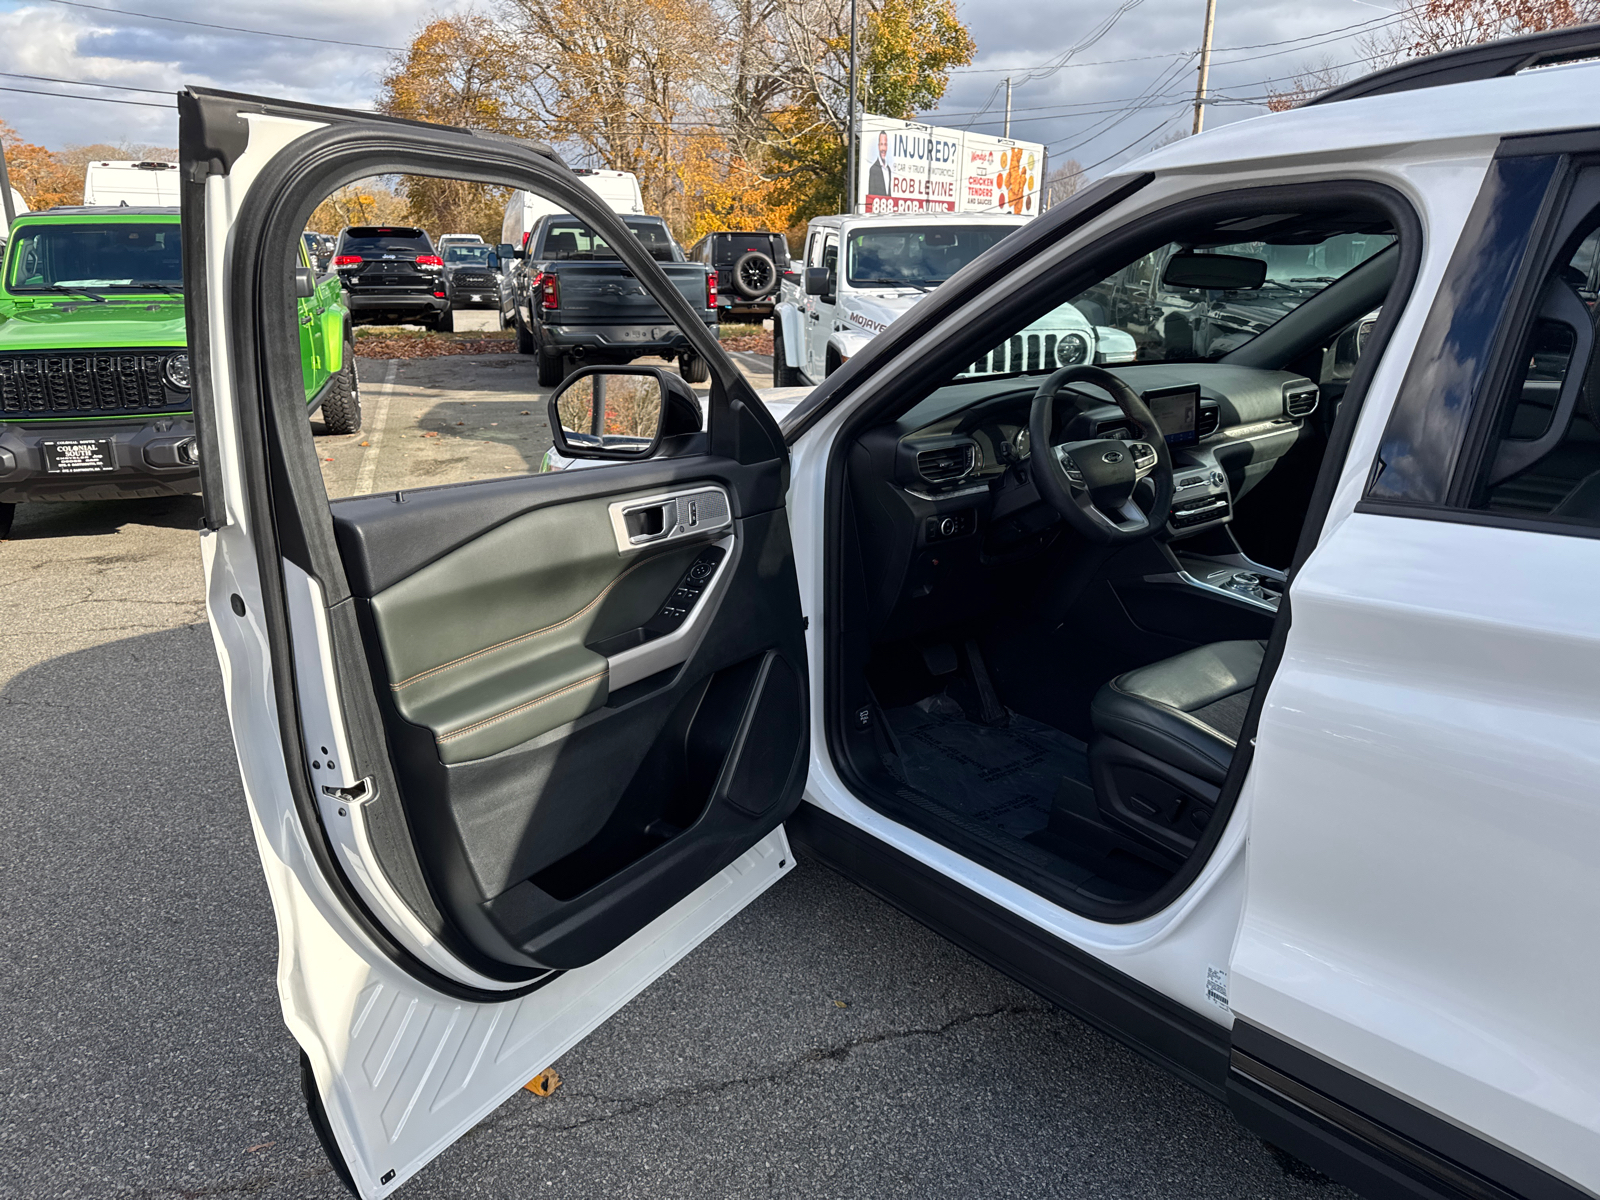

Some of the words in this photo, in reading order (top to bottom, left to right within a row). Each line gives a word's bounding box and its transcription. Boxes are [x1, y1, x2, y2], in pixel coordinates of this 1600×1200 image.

[893, 133, 957, 164] INJURED?
[893, 177, 915, 194] ROB
[918, 179, 954, 197] LEVINE
[968, 176, 994, 187] CHICKEN
[968, 186, 993, 197] TENDERS
[850, 311, 887, 332] MOJAVE
[56, 444, 98, 453] COLONIAL
